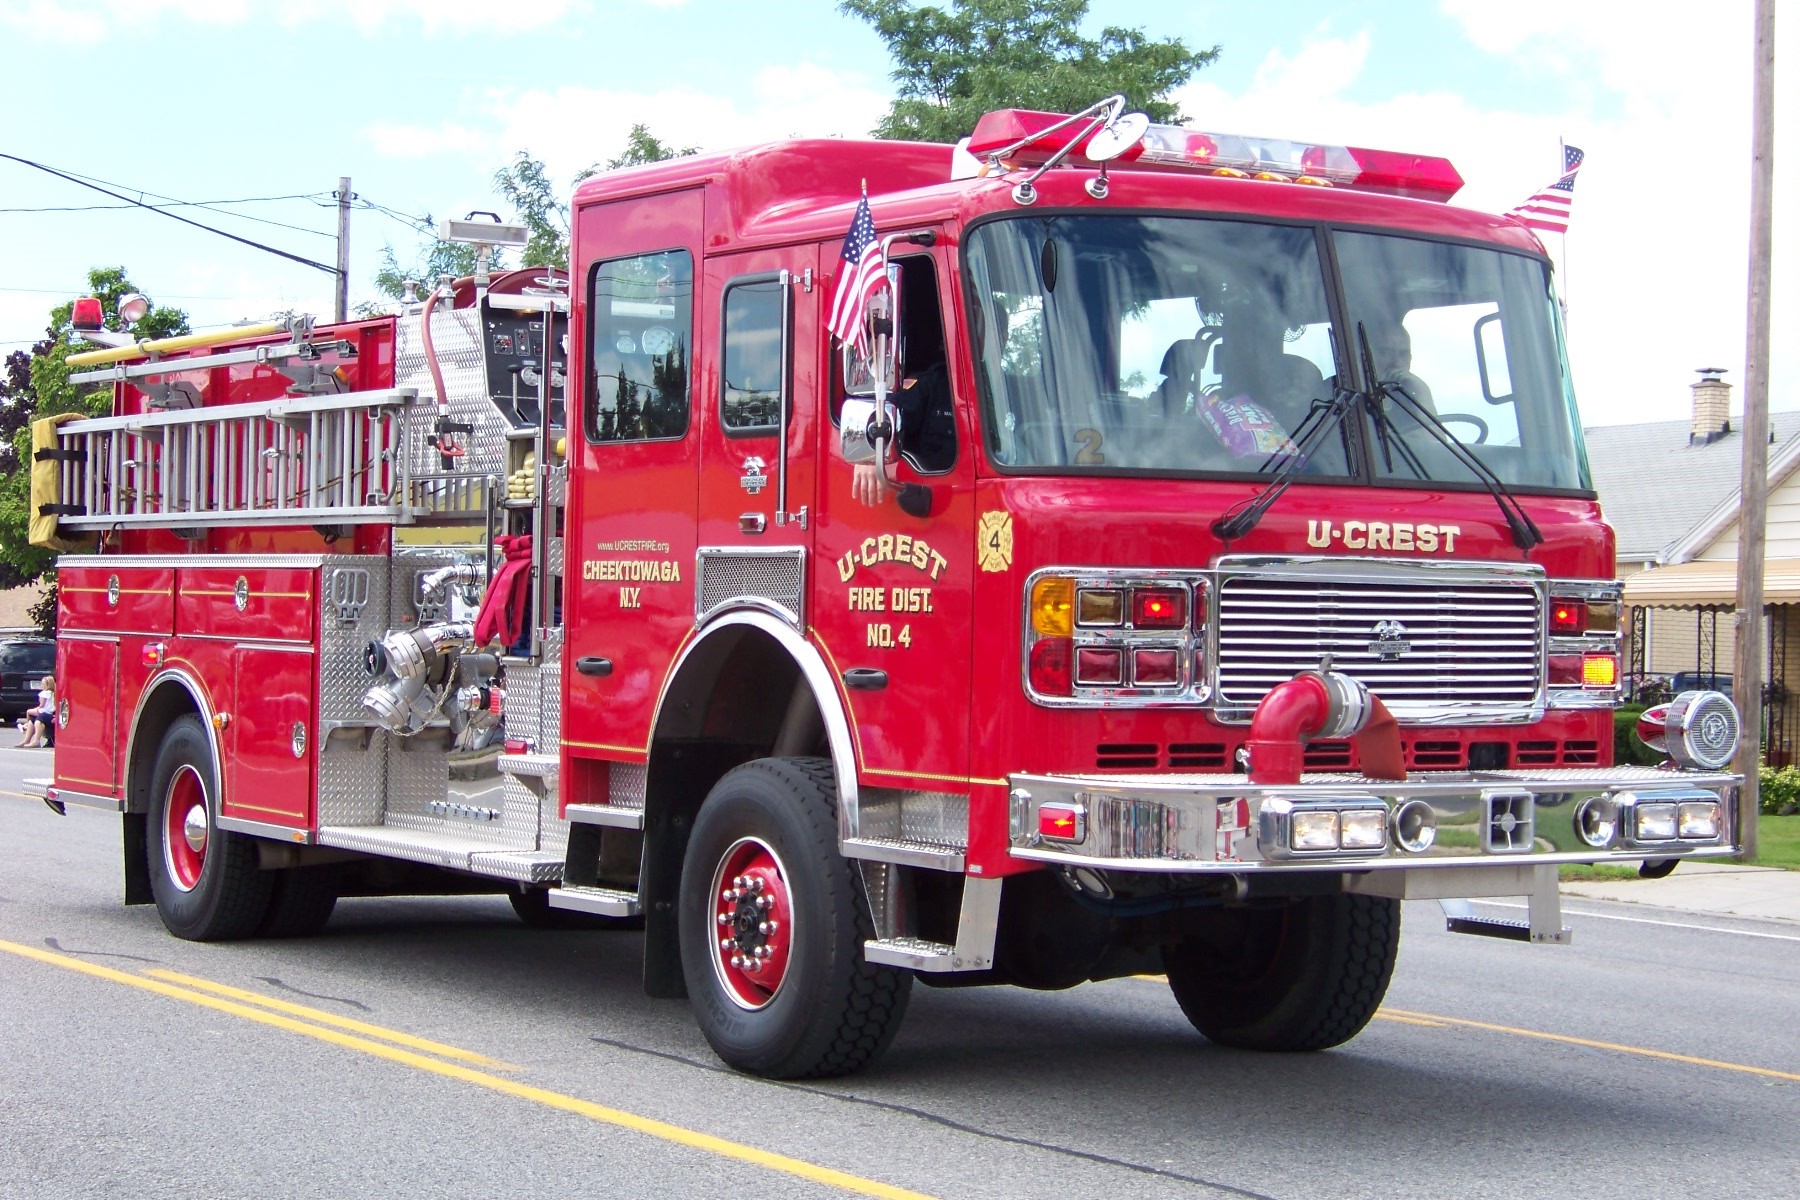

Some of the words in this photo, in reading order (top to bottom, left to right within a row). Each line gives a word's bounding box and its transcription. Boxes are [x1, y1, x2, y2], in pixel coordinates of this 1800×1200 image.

[1073, 428, 1105, 464] 2
[597, 540, 670, 554] www.UCRESTFIRE.org
[989, 530, 1001, 552] 4
[1307, 520, 1461, 553] U-CREST
[837, 533, 948, 583] U-CREST
[583, 560, 681, 582] CHEEKTOWAGA
[619, 587, 641, 608] N.Y.
[848, 587, 885, 610] FIRE
[892, 587, 933, 612] DIST.
[867, 623, 895, 647] NO.
[898, 624, 912, 648] 4
